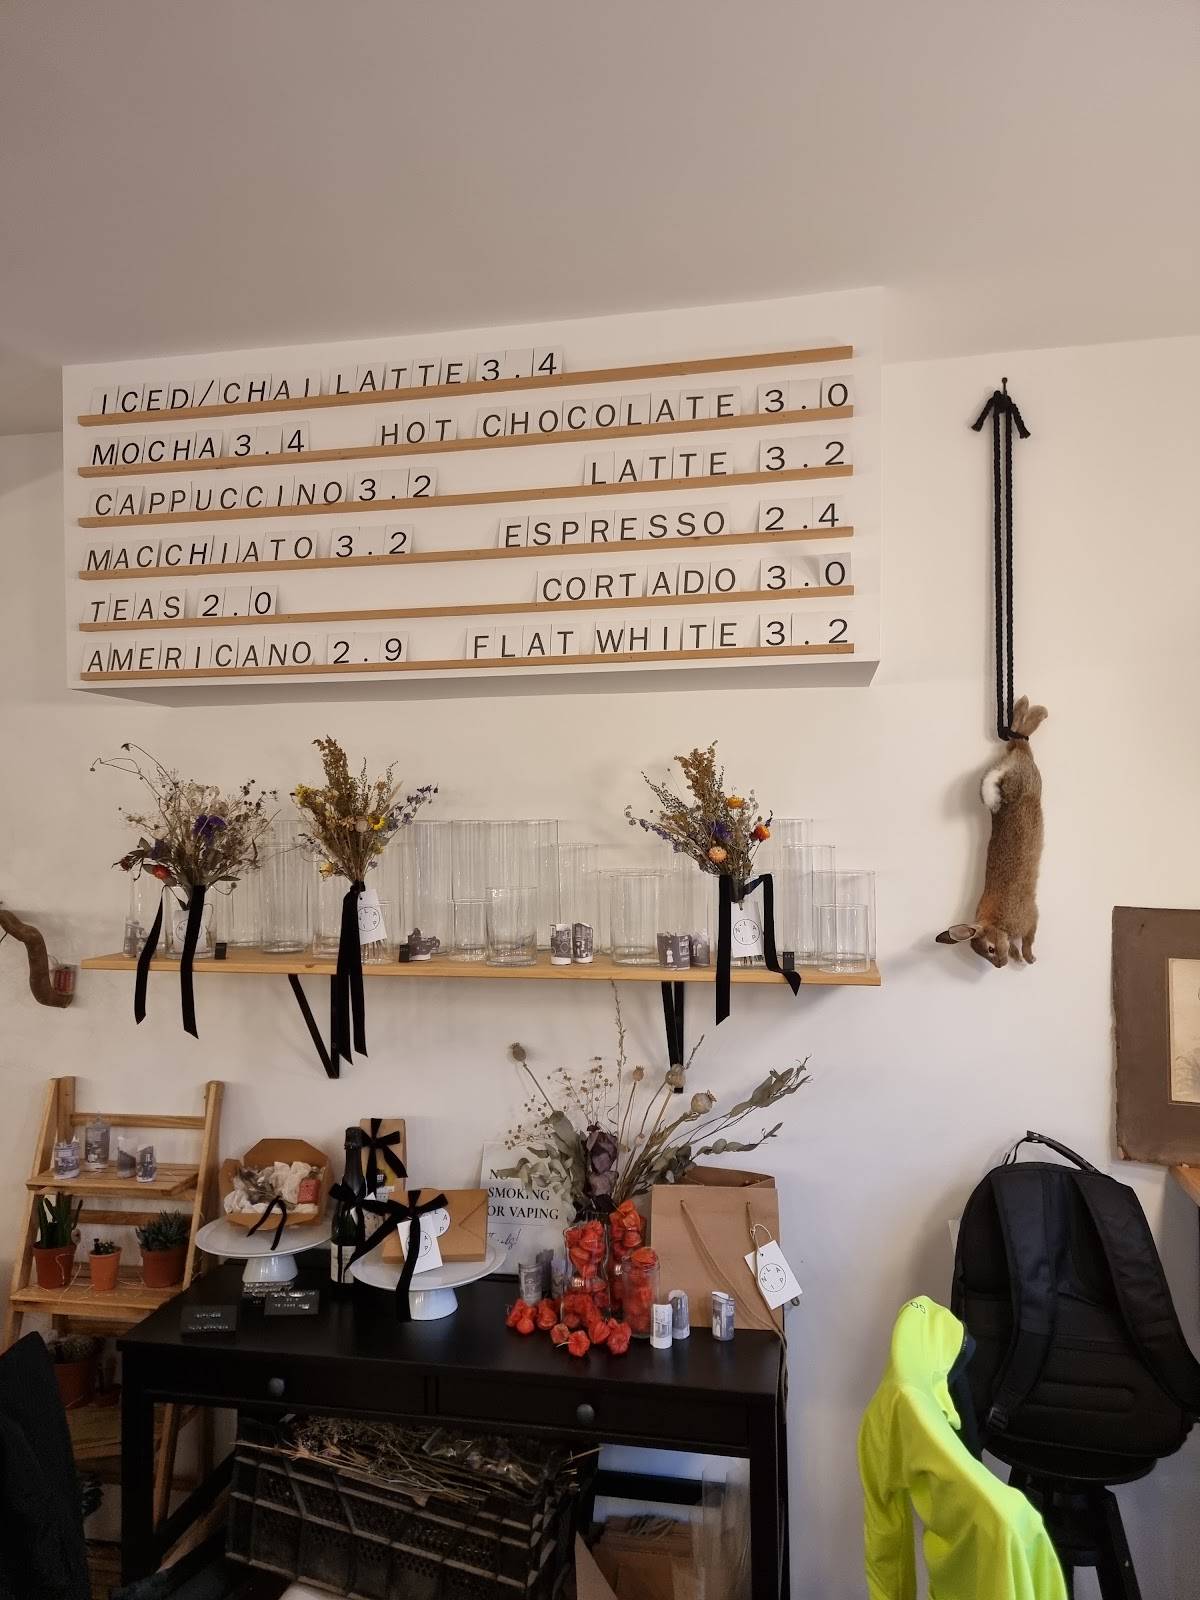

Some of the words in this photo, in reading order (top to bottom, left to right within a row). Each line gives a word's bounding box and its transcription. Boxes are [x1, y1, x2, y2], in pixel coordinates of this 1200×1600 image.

[101, 378, 310, 416] ICED/CHAI
[335, 362, 463, 395] LATTE
[481, 351, 557, 382] 3.4
[380, 419, 452, 447] HOT
[482, 393, 734, 438] CHOCOLATE
[764, 383, 848, 413] 3.0
[92, 437, 215, 467] MOCHA
[234, 429, 305, 457] 3.4
[591, 451, 727, 486] LATTE
[765, 441, 845, 471] 3.2
[95, 481, 343, 516] CAPPUCCINO
[358, 474, 431, 502] 3.2
[505, 511, 725, 548] ESPRESSO
[765, 503, 839, 531] 2.4
[86, 536, 313, 571] MACCHIATO
[335, 531, 407, 558] 3.2
[542, 568, 736, 602] CORTADO
[766, 561, 846, 591] 3.0
[91, 596, 180, 623] TEAS
[202, 591, 272, 617] 2.0
[87, 641, 312, 673] AMERICANO
[333, 637, 402, 665] 2.9
[473, 631, 574, 659] FLAT
[596, 622, 737, 653] WHITE
[765, 618, 848, 646] 3.2
[488, 1186, 550, 1201] SMOKNG
[488, 1205, 505, 1217] OR
[509, 1206, 559, 1220] VAPING
